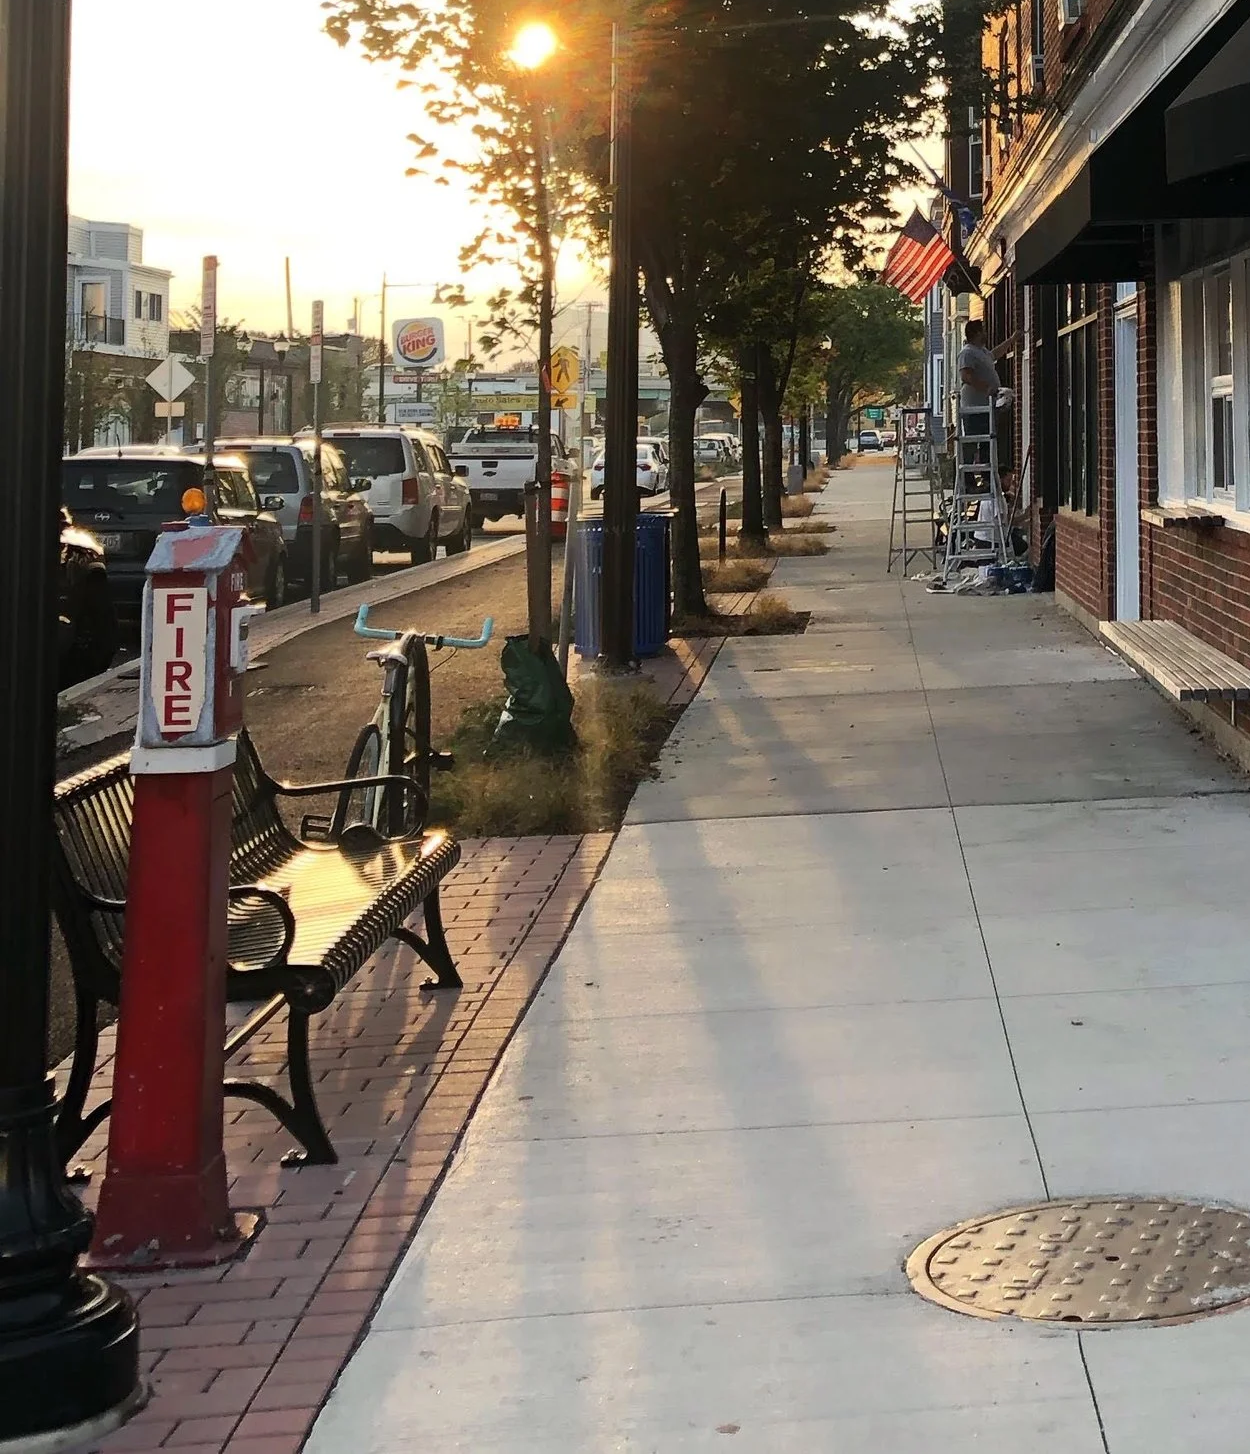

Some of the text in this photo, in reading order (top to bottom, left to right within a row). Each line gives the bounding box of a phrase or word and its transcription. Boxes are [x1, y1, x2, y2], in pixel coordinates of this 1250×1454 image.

[400, 327, 434, 345] BURGER
[402, 335, 436, 356] KING
[230, 572, 244, 592] FIRE
[163, 593, 195, 726] FIRE
